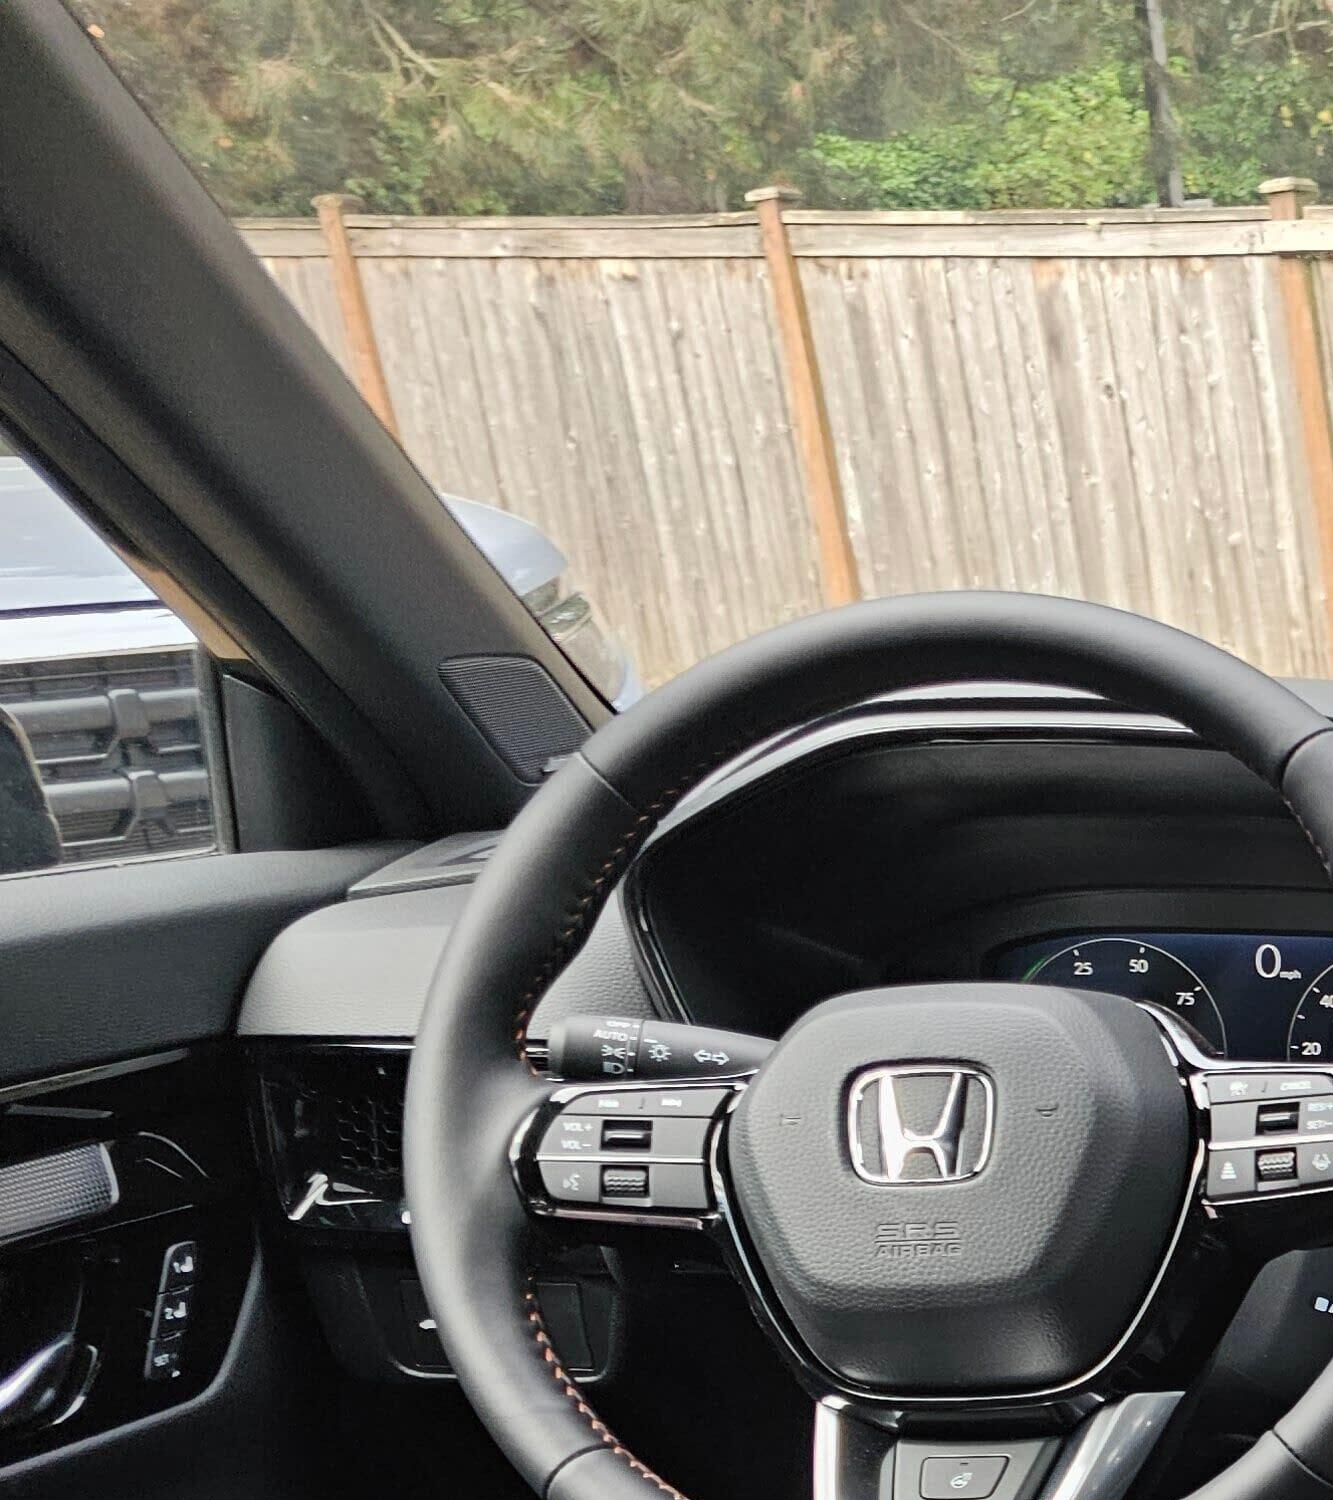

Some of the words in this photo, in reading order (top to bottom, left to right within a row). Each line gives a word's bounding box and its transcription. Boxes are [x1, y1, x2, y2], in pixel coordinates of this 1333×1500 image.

[1073, 961, 1094, 976] 25
[1128, 958, 1149, 973] 50
[1255, 943, 1282, 979] 0
[1175, 992, 1196, 1006] 75
[592, 1029, 629, 1042] AUTO
[1301, 1041, 1322, 1056] 20
[874, 1221, 959, 1239] SRS
[874, 1242, 963, 1258] AIRBAG
